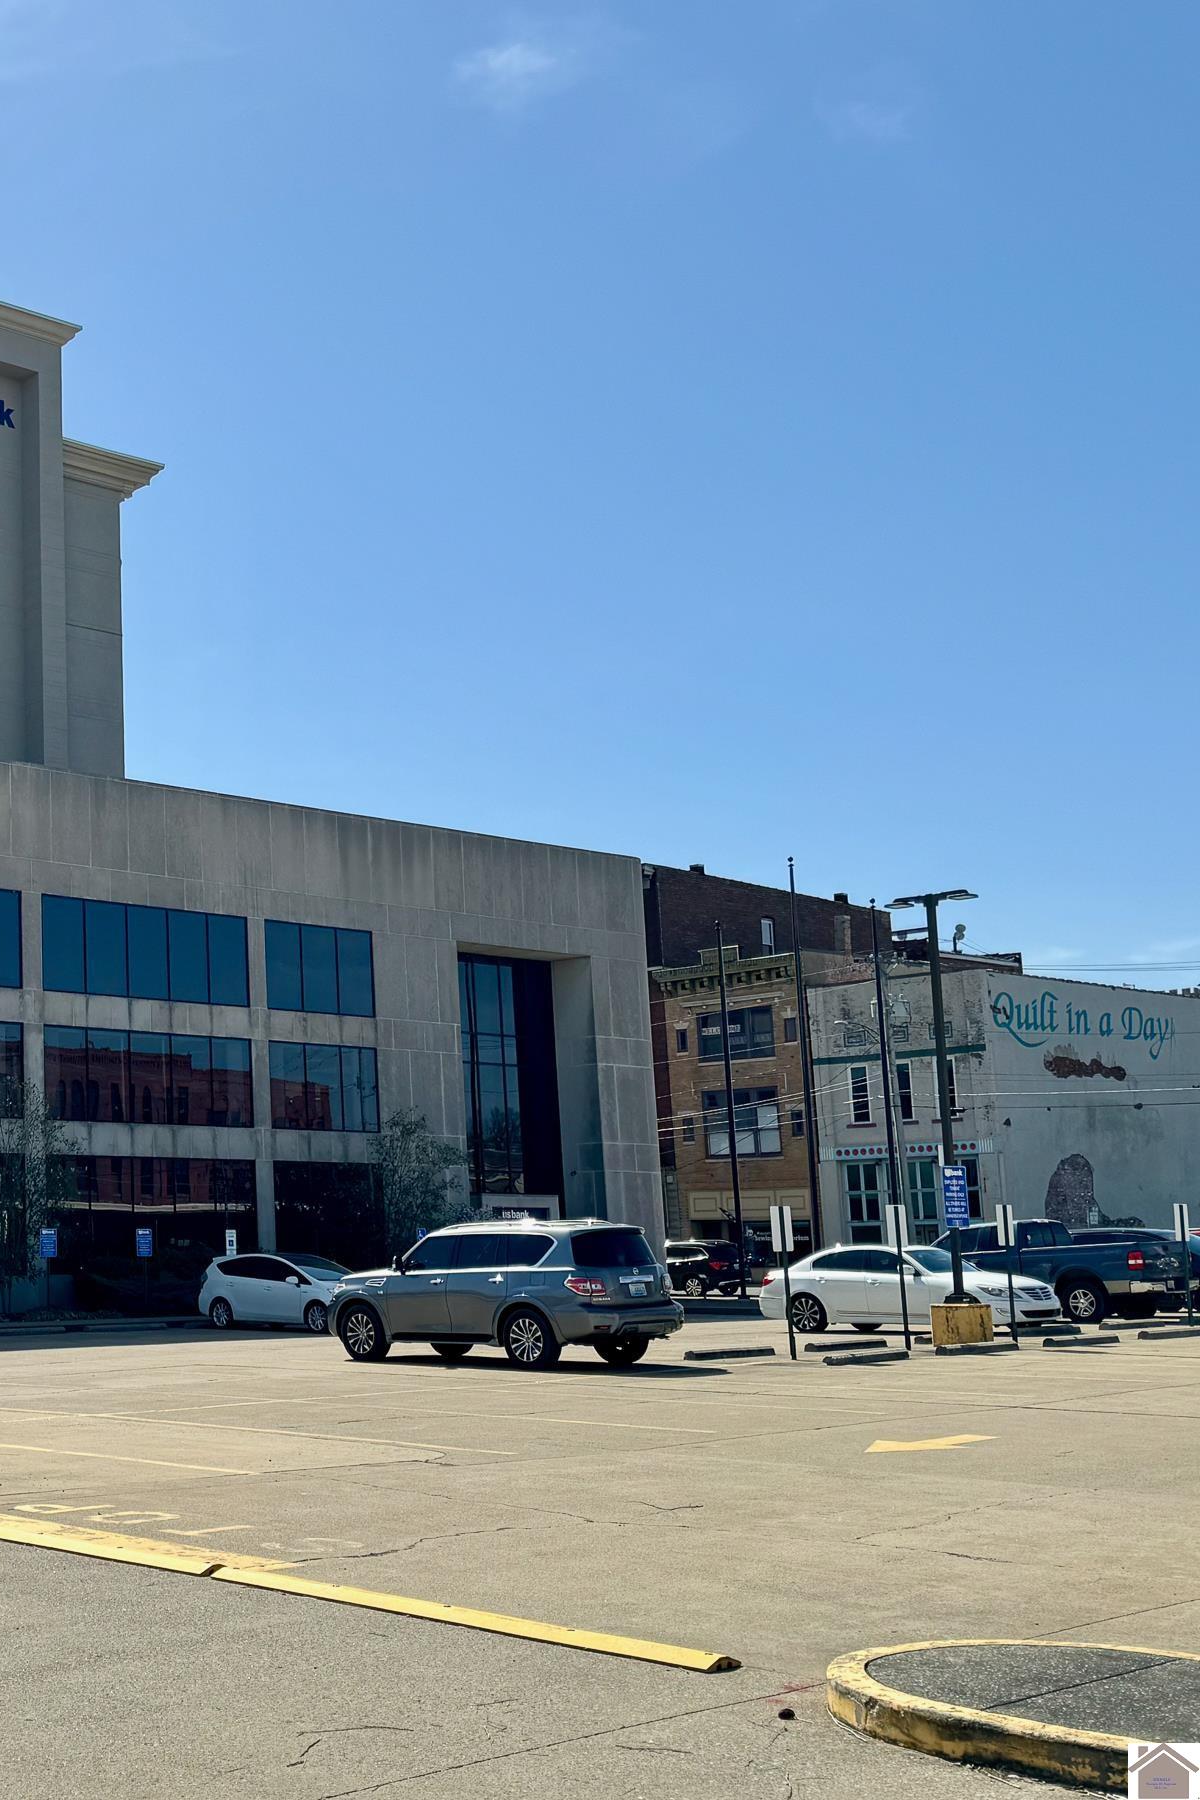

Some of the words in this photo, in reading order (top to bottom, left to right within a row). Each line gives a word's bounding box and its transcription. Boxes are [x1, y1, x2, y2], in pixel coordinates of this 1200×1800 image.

[992, 991, 1059, 1048] Quilt
[1066, 1001, 1090, 1037] in
[1100, 1012, 1114, 1037] a
[1121, 1007, 1169, 1060] Day
